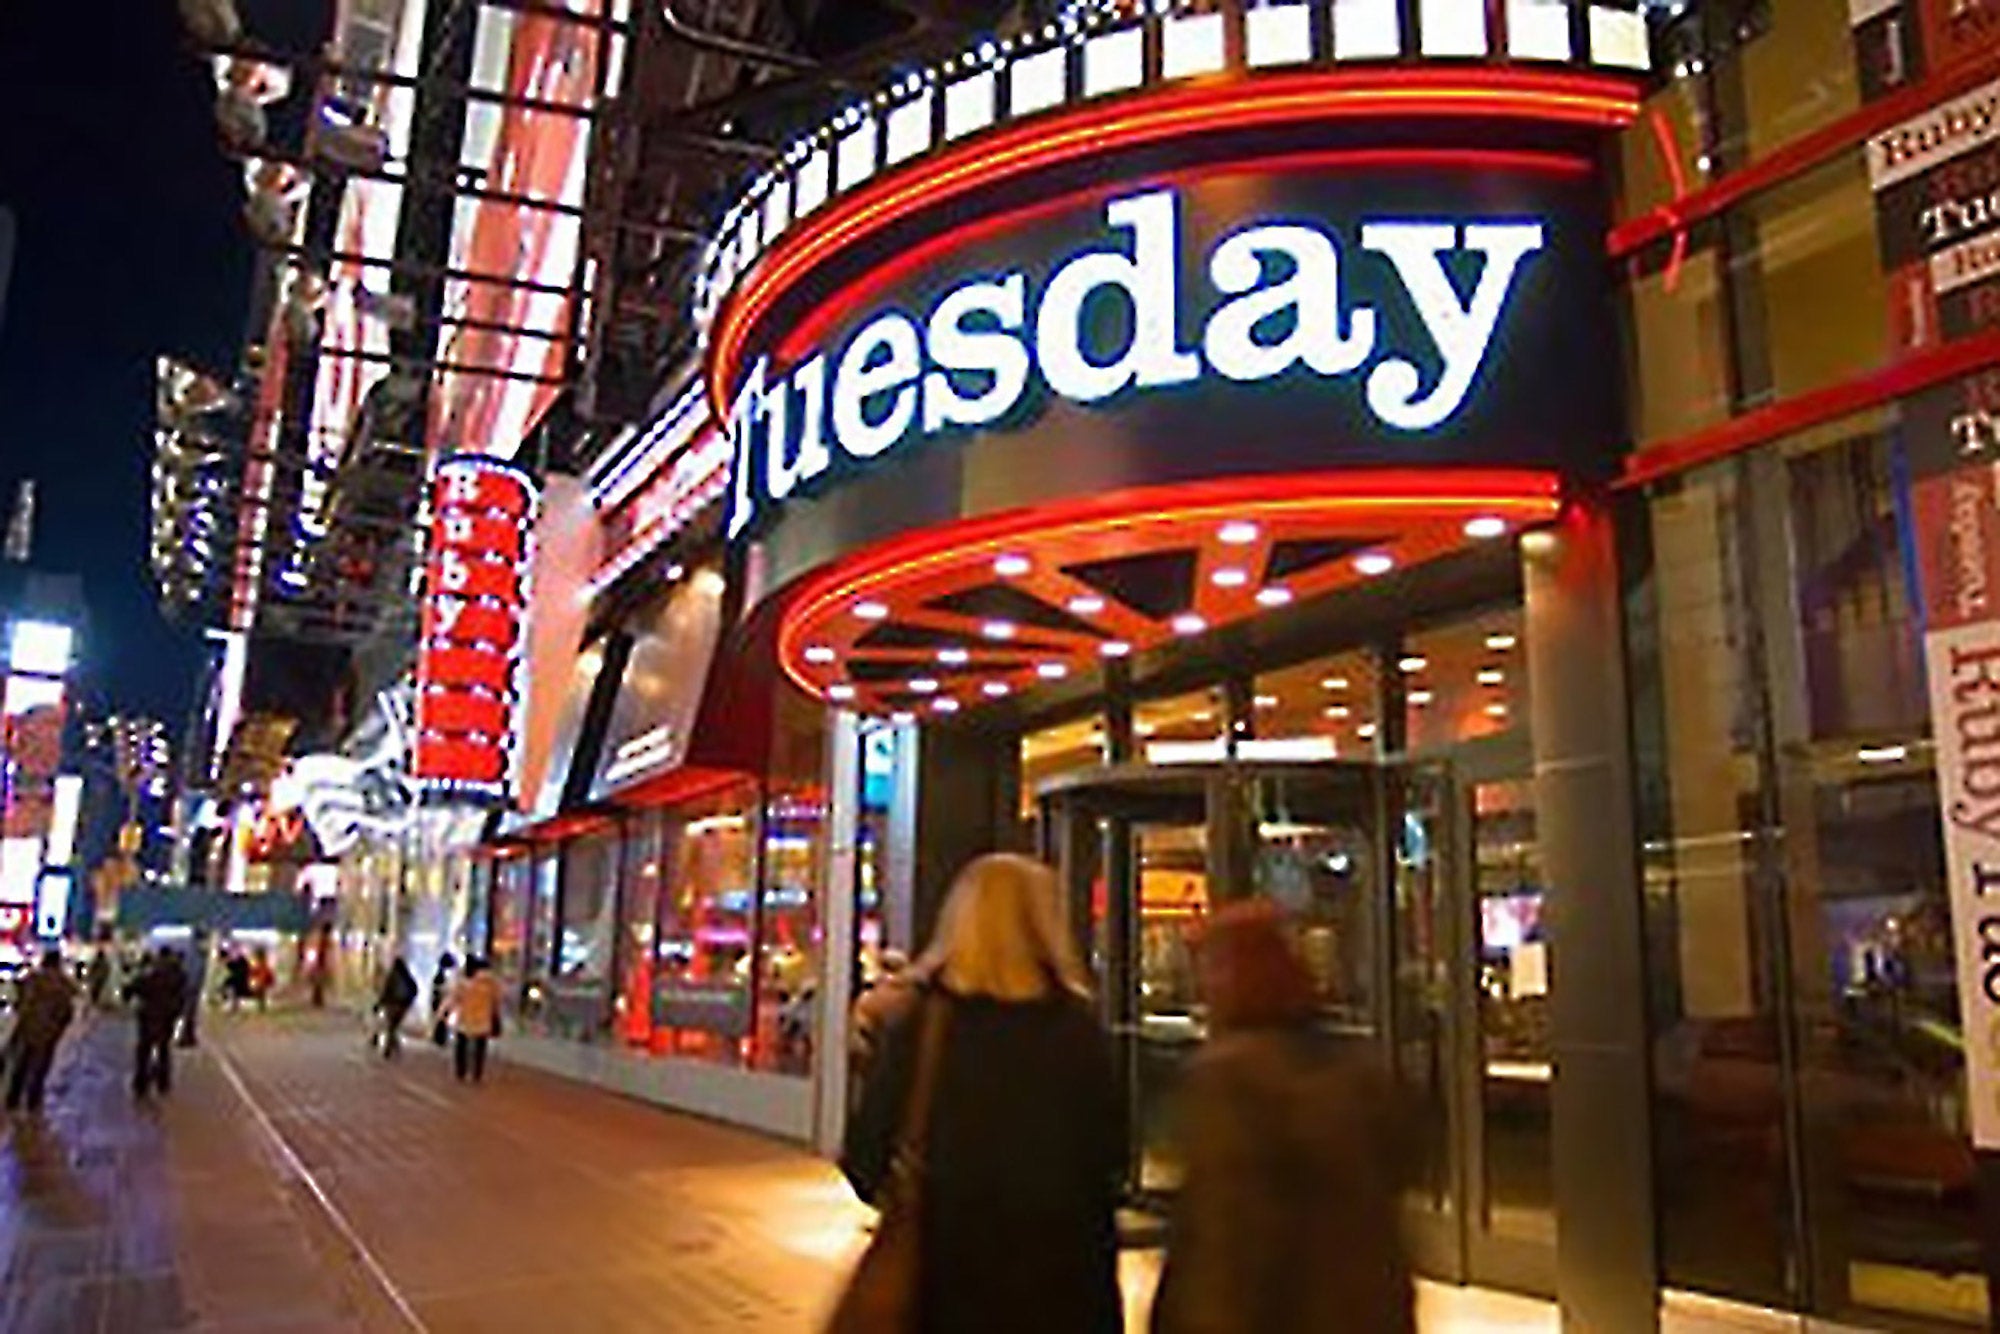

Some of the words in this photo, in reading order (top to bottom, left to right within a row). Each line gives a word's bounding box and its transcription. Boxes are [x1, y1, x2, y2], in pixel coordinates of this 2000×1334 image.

[1880, 97, 1997, 167] Ruby
[726, 188, 1545, 539] Tuesday
[435, 464, 479, 635] Ruby
[1947, 647, 2000, 840] Ruby
